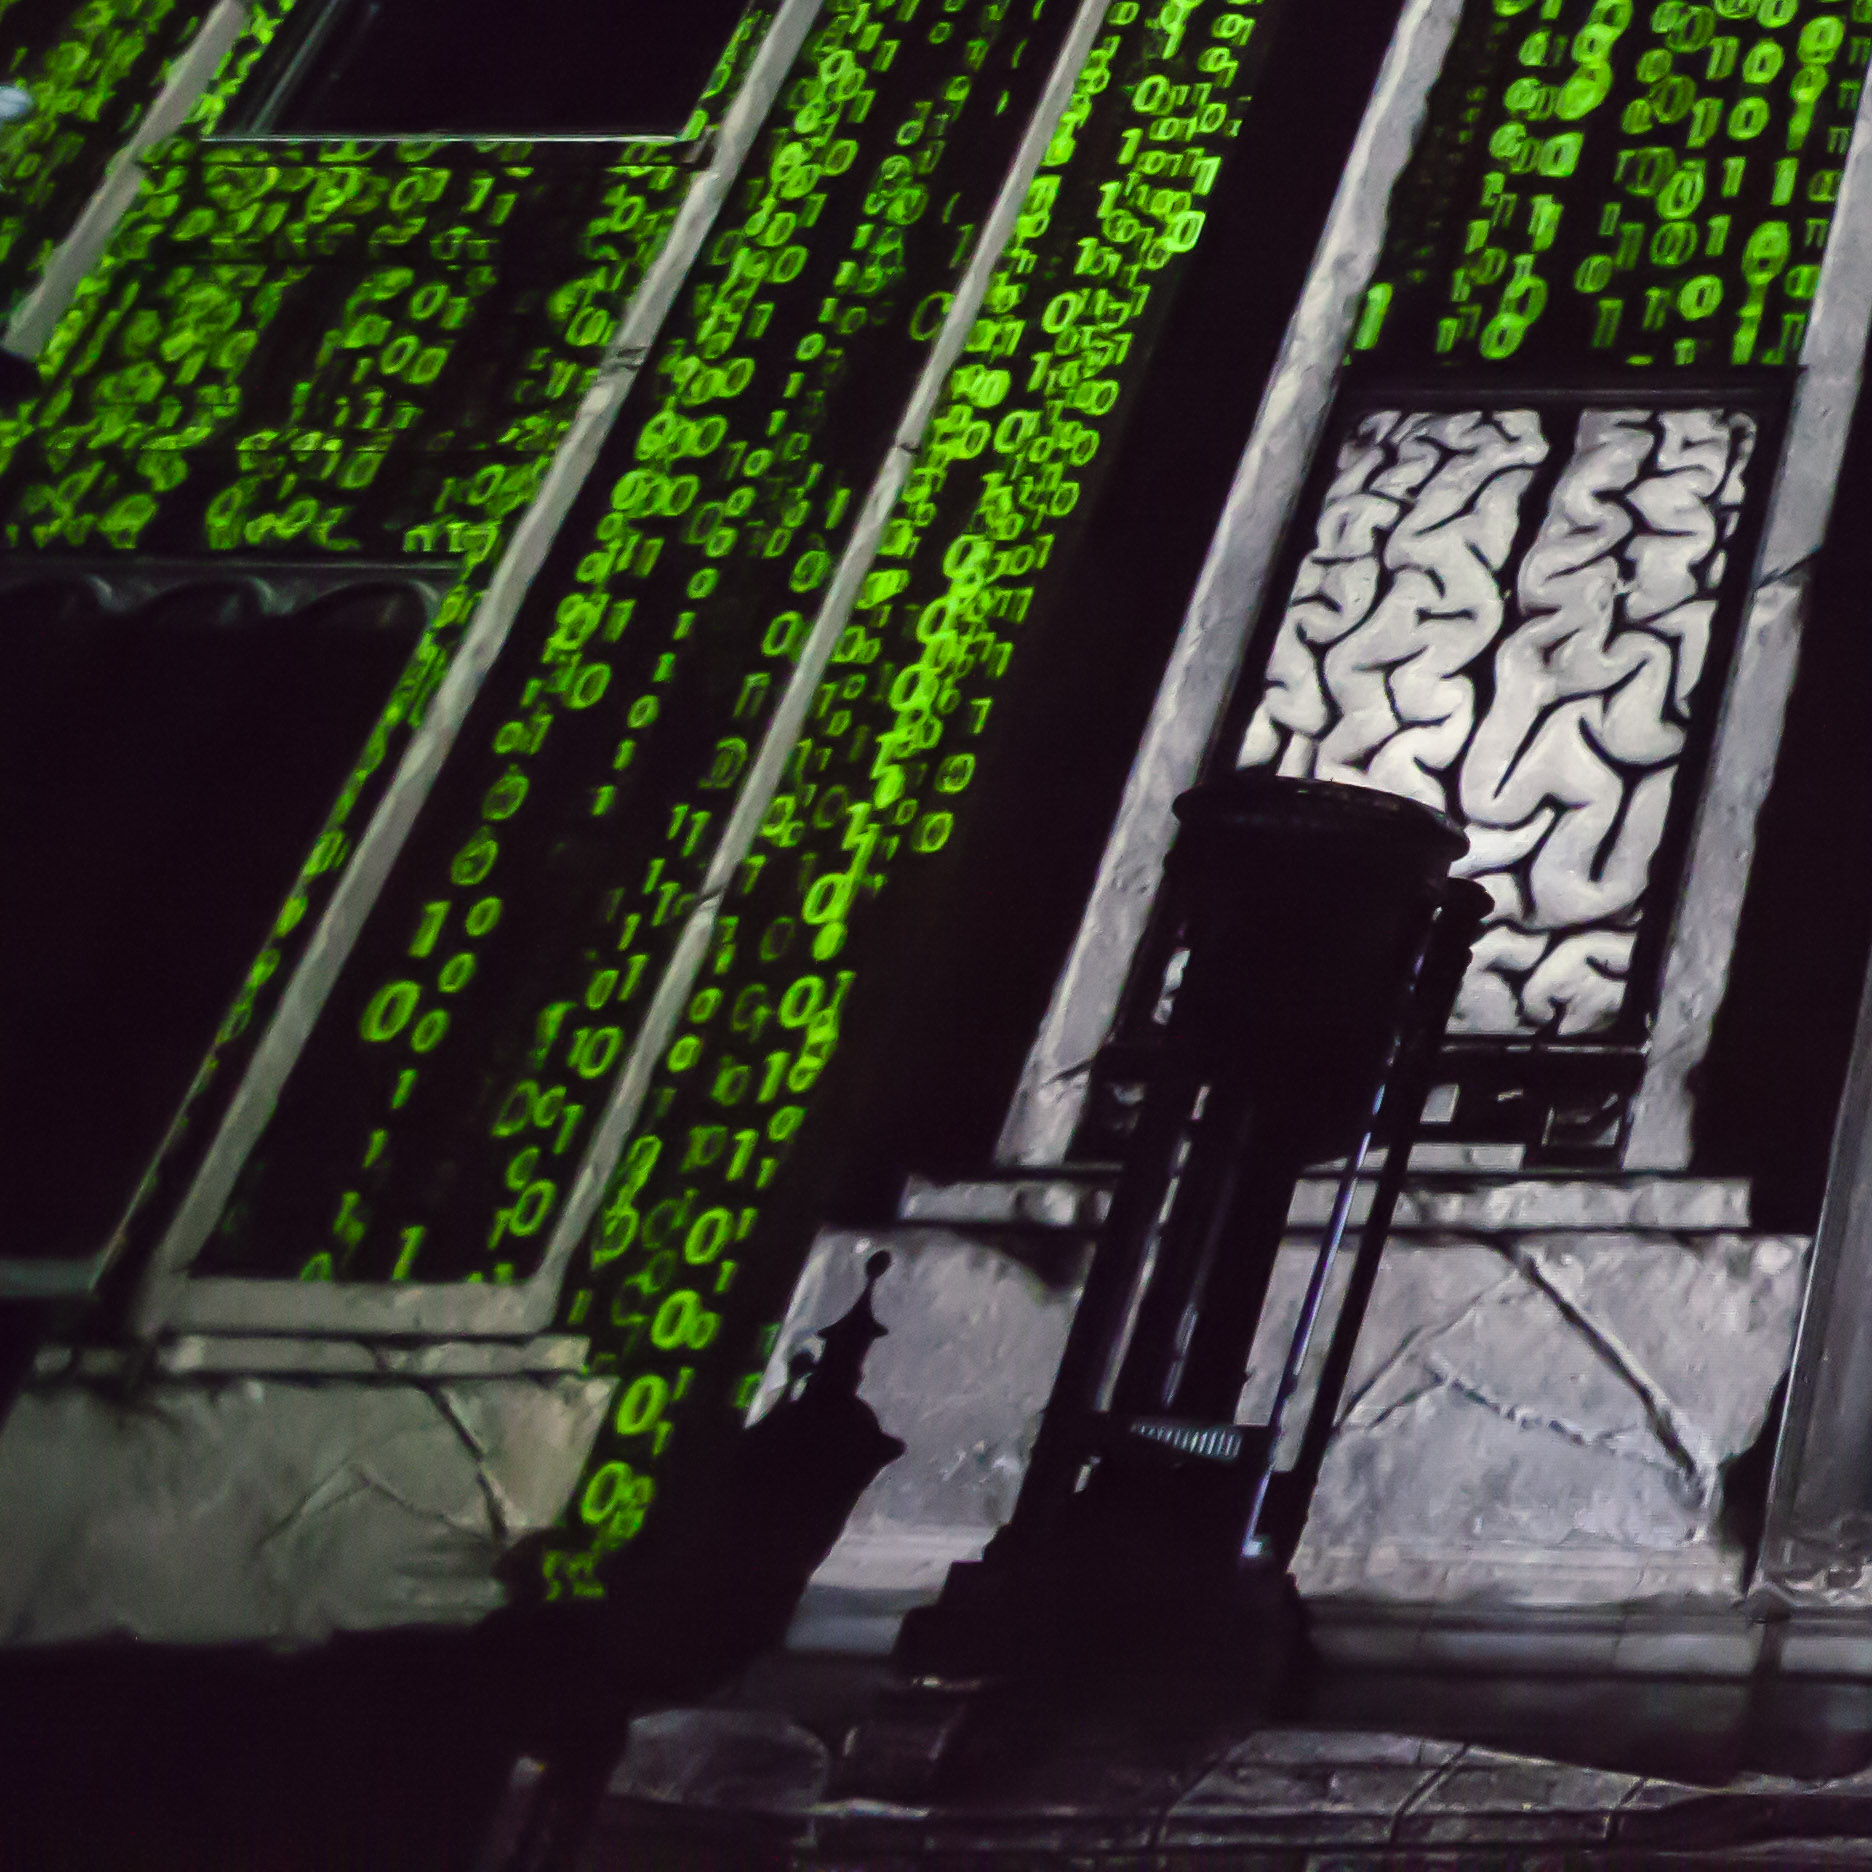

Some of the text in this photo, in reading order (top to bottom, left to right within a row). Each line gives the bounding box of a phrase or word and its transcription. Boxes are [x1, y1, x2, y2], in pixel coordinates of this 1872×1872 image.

[873, 40, 900, 71] 1
[1118, 128, 1143, 164] 1
[462, 172, 495, 212] 1
[1722, 157, 1746, 196] 1
[1771, 157, 1799, 206] 1
[1706, 215, 1730, 255] 1
[1029, 352, 1052, 389] 1
[410, 901, 450, 958] 1
[758, 1050, 790, 1103] 1
[726, 1129, 758, 1181] 1
